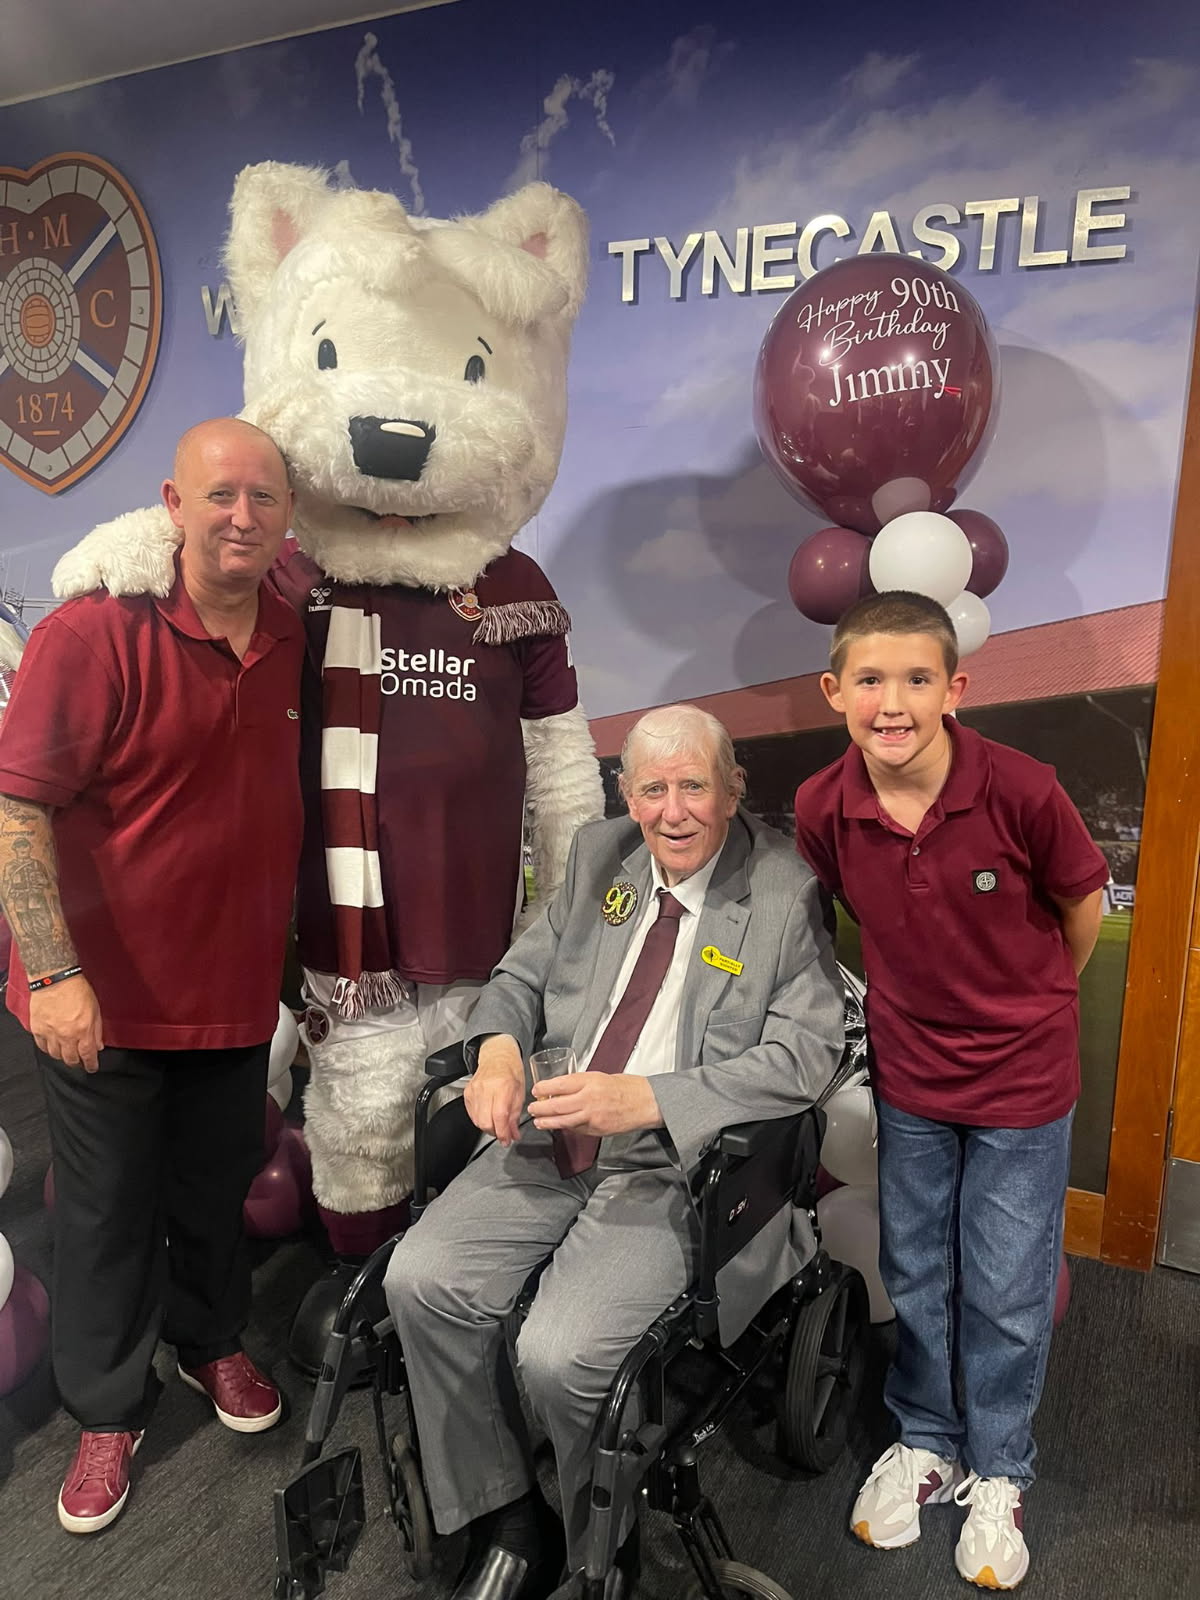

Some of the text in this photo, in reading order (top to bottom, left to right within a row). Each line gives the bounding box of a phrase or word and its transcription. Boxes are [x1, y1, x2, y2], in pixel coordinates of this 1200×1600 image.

[608, 186, 1130, 302] TYNECASTLE
[90, 289, 118, 328] C
[797, 277, 961, 333] Happy 90th
[818, 307, 952, 367] Birthday
[828, 357, 952, 407] Jimmy
[16, 391, 75, 424] 1874
[381, 648, 475, 677] Stellar
[380, 672, 477, 702] Omada
[603, 886, 634, 918] 90
